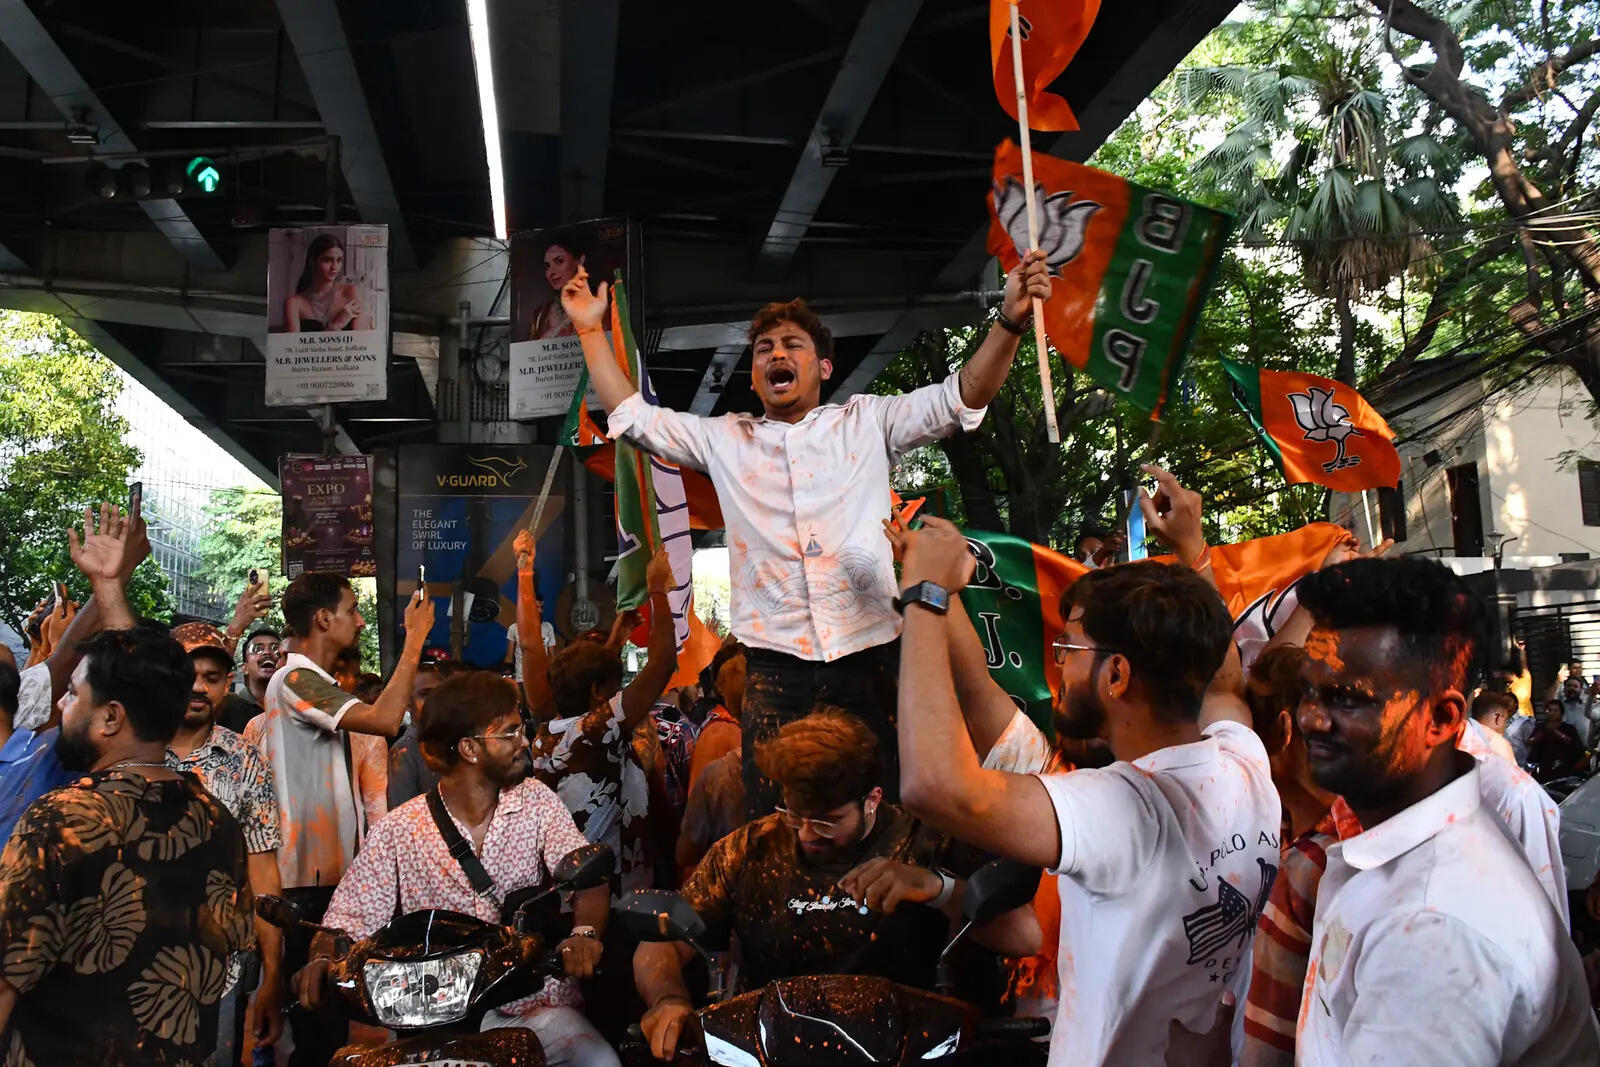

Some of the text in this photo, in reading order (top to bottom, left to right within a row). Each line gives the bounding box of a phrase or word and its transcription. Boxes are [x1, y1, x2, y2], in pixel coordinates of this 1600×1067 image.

[318, 336, 341, 344] SONS
[342, 335, 353, 344] (J)
[561, 340, 581, 350] SON
[294, 355, 343, 365] JEWELLERS
[344, 354, 352, 362] &
[353, 354, 376, 362] SONS
[335, 364, 360, 372] Kolkata
[307, 483, 346, 495] EXPO
[412, 509, 433, 519] THE
[412, 519, 458, 529] ELEGANT
[412, 530, 443, 540] SWIRL
[411, 541, 467, 550] OF LUXURY
